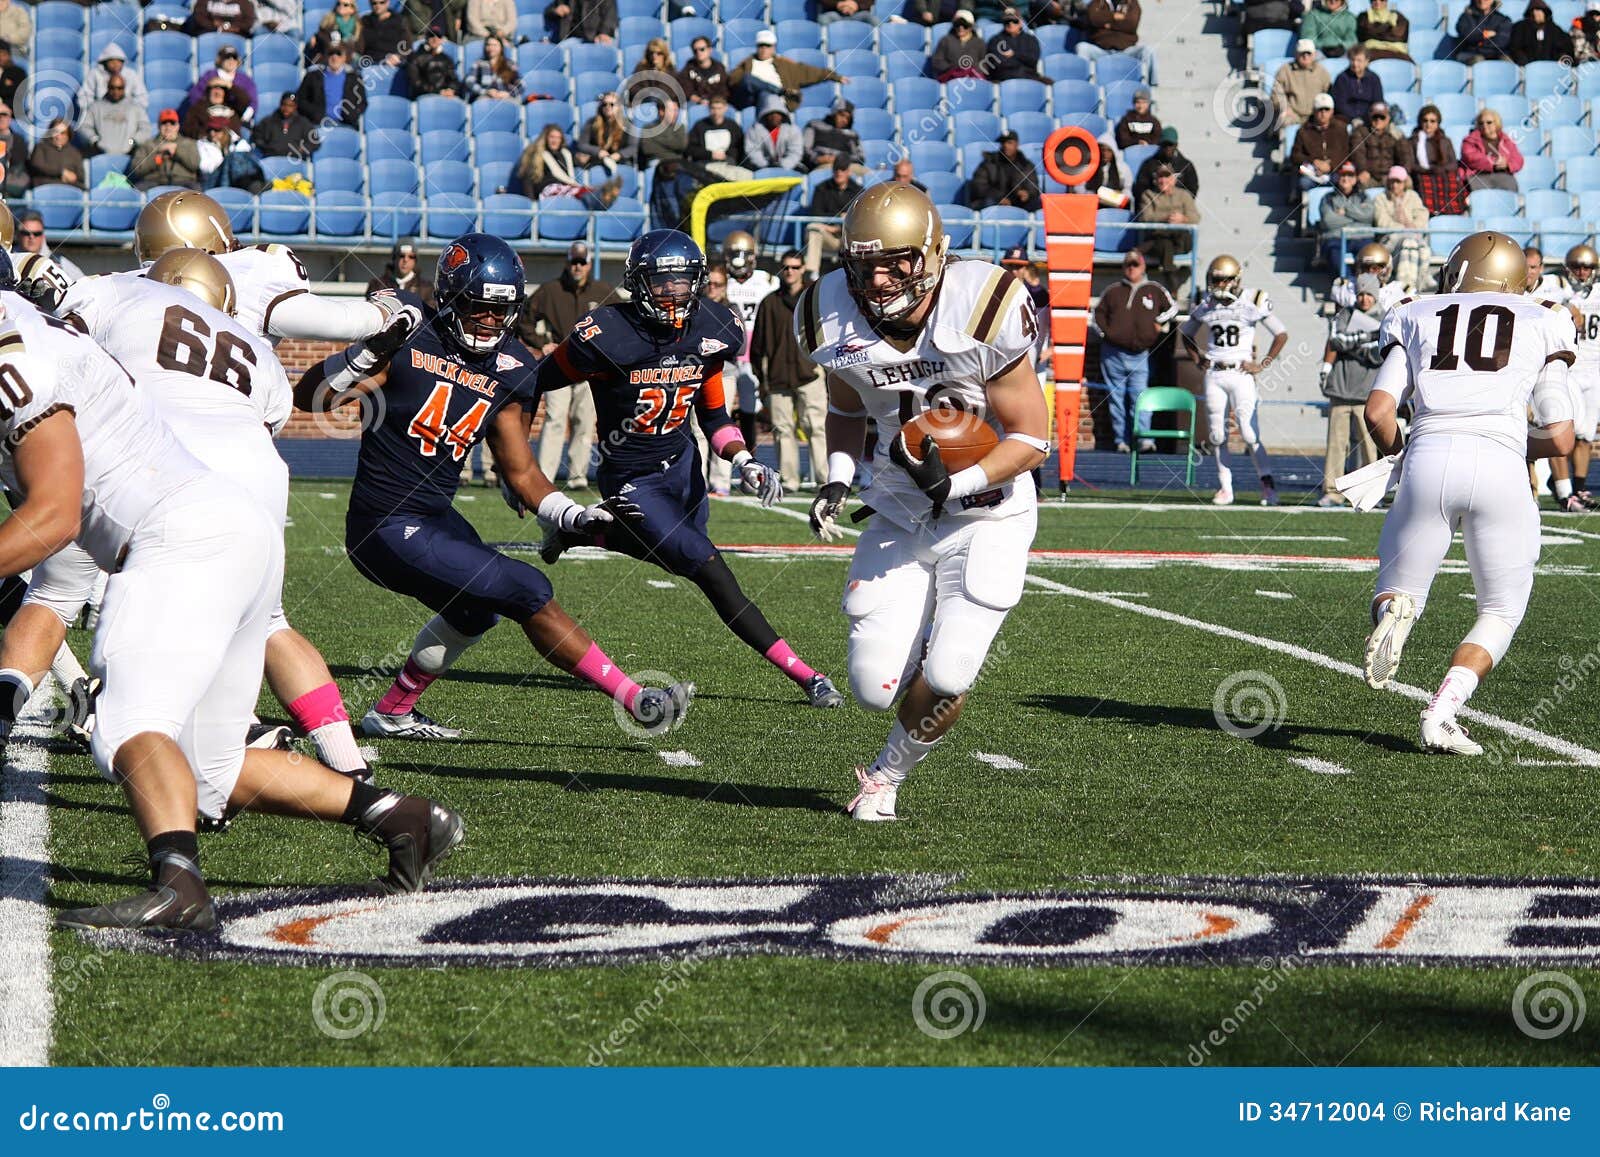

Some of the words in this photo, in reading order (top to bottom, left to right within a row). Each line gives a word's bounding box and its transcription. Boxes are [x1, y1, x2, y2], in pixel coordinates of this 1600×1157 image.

[573, 315, 603, 343] 25
[1211, 324, 1240, 347] 28
[1430, 303, 1516, 371] 10
[156, 304, 259, 398] 66
[411, 348, 500, 398] BUCKNELL
[630, 365, 704, 384] BUCKNELL
[867, 361, 946, 387] LEHIGH
[407, 380, 492, 462] 44
[632, 383, 702, 435] 25
[1439, 721, 1456, 737] NIKE
